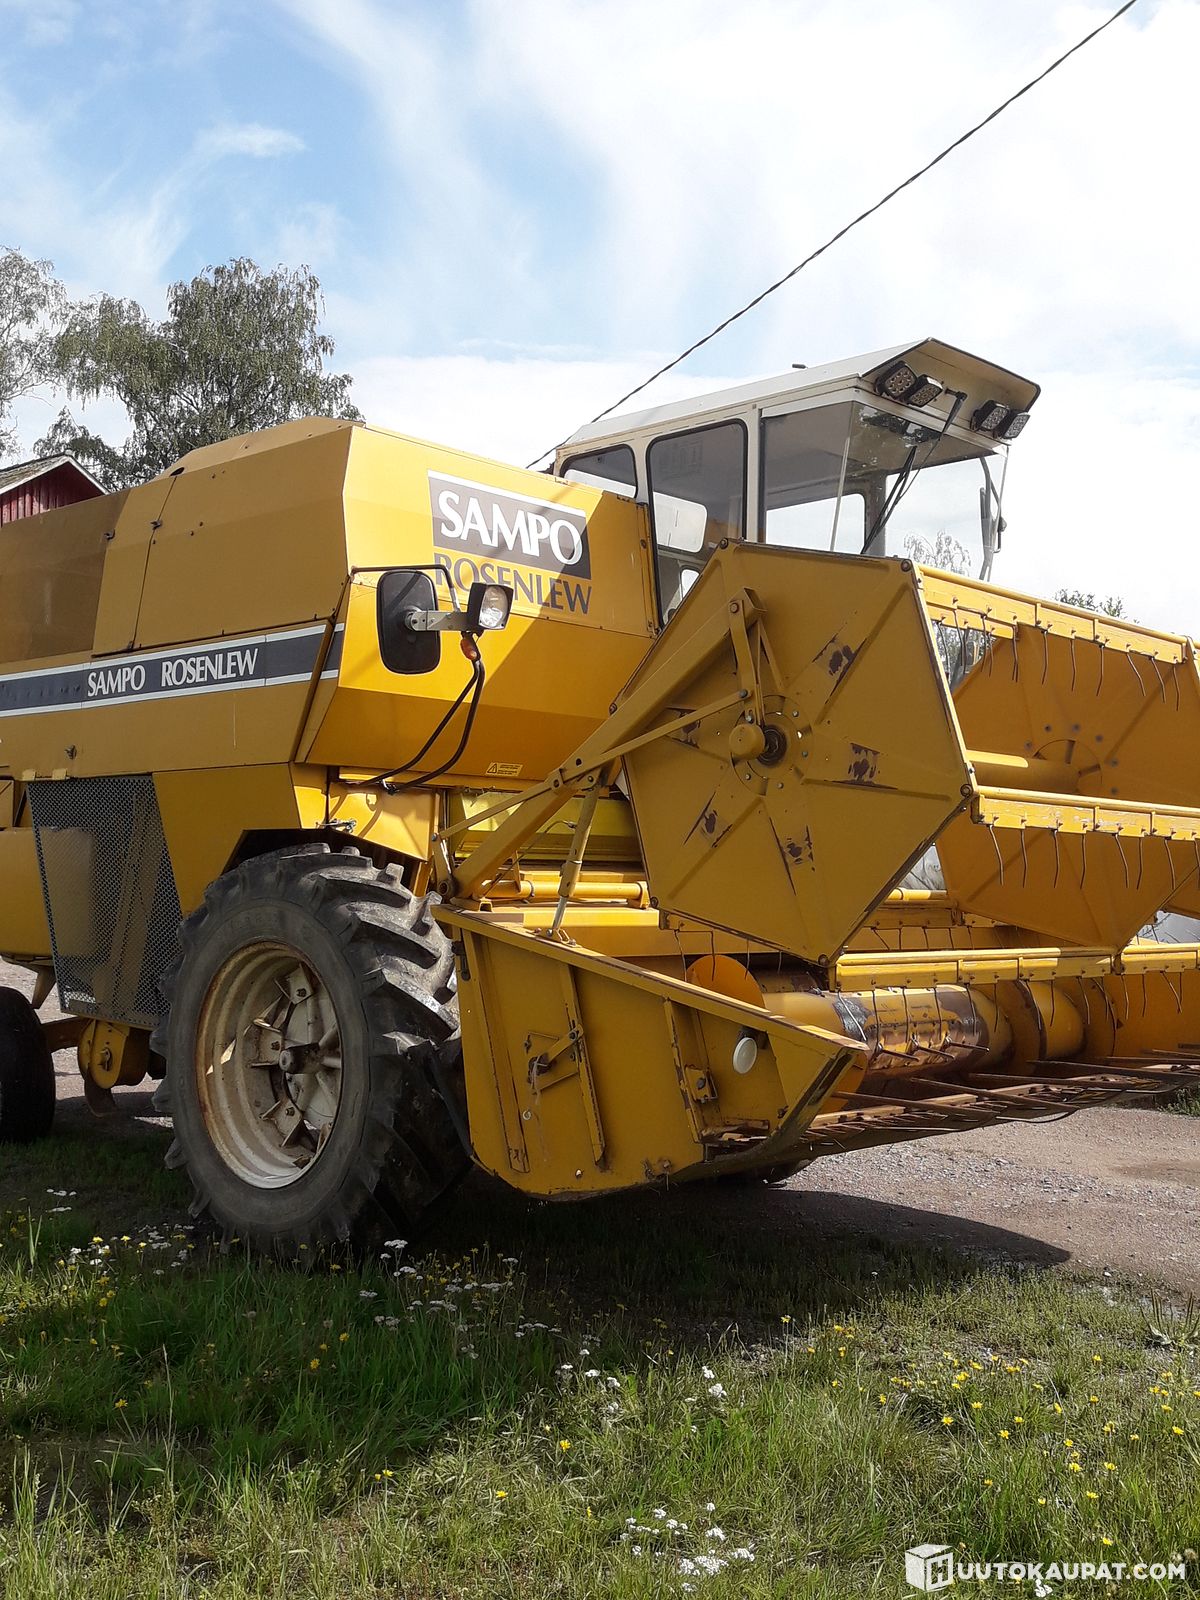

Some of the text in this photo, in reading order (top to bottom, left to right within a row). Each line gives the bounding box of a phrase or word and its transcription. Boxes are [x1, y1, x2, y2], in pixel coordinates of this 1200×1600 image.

[438, 490, 583, 565] SAMPO
[434, 552, 592, 614] ROSENLEW
[87, 648, 259, 697] SAMPO ROSENLEW
